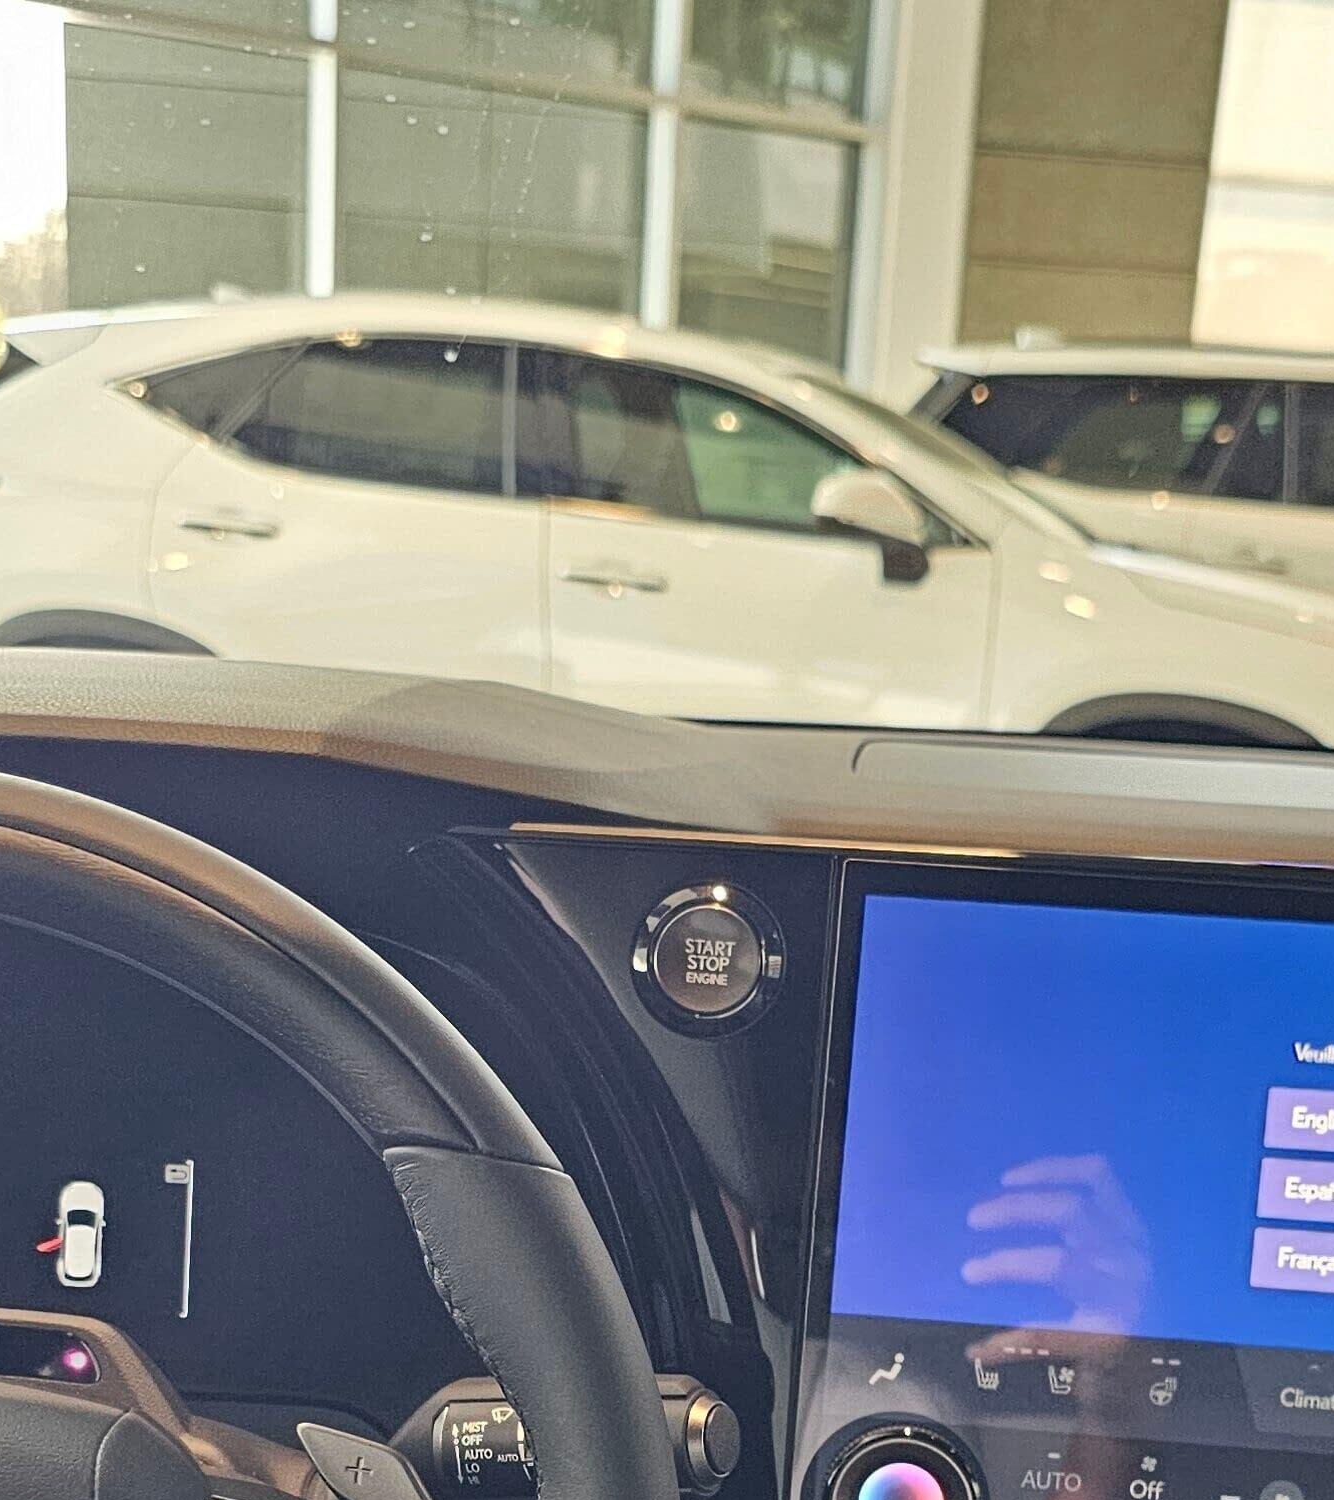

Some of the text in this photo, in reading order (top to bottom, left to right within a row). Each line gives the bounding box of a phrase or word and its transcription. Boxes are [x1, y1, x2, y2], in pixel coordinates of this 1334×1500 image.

[684, 937, 737, 957] START
[686, 954, 730, 972] STOP
[685, 971, 729, 986] ENGINE
[462, 1421, 489, 1434] MIST
[461, 1434, 484, 1446] OFF
[464, 1448, 493, 1461] AUTO
[497, 1453, 519, 1463] AUTO
[465, 1462, 480, 1473] LO
[1020, 1469, 1082, 1492] AUTO
[1129, 1479, 1165, 1500] Off
